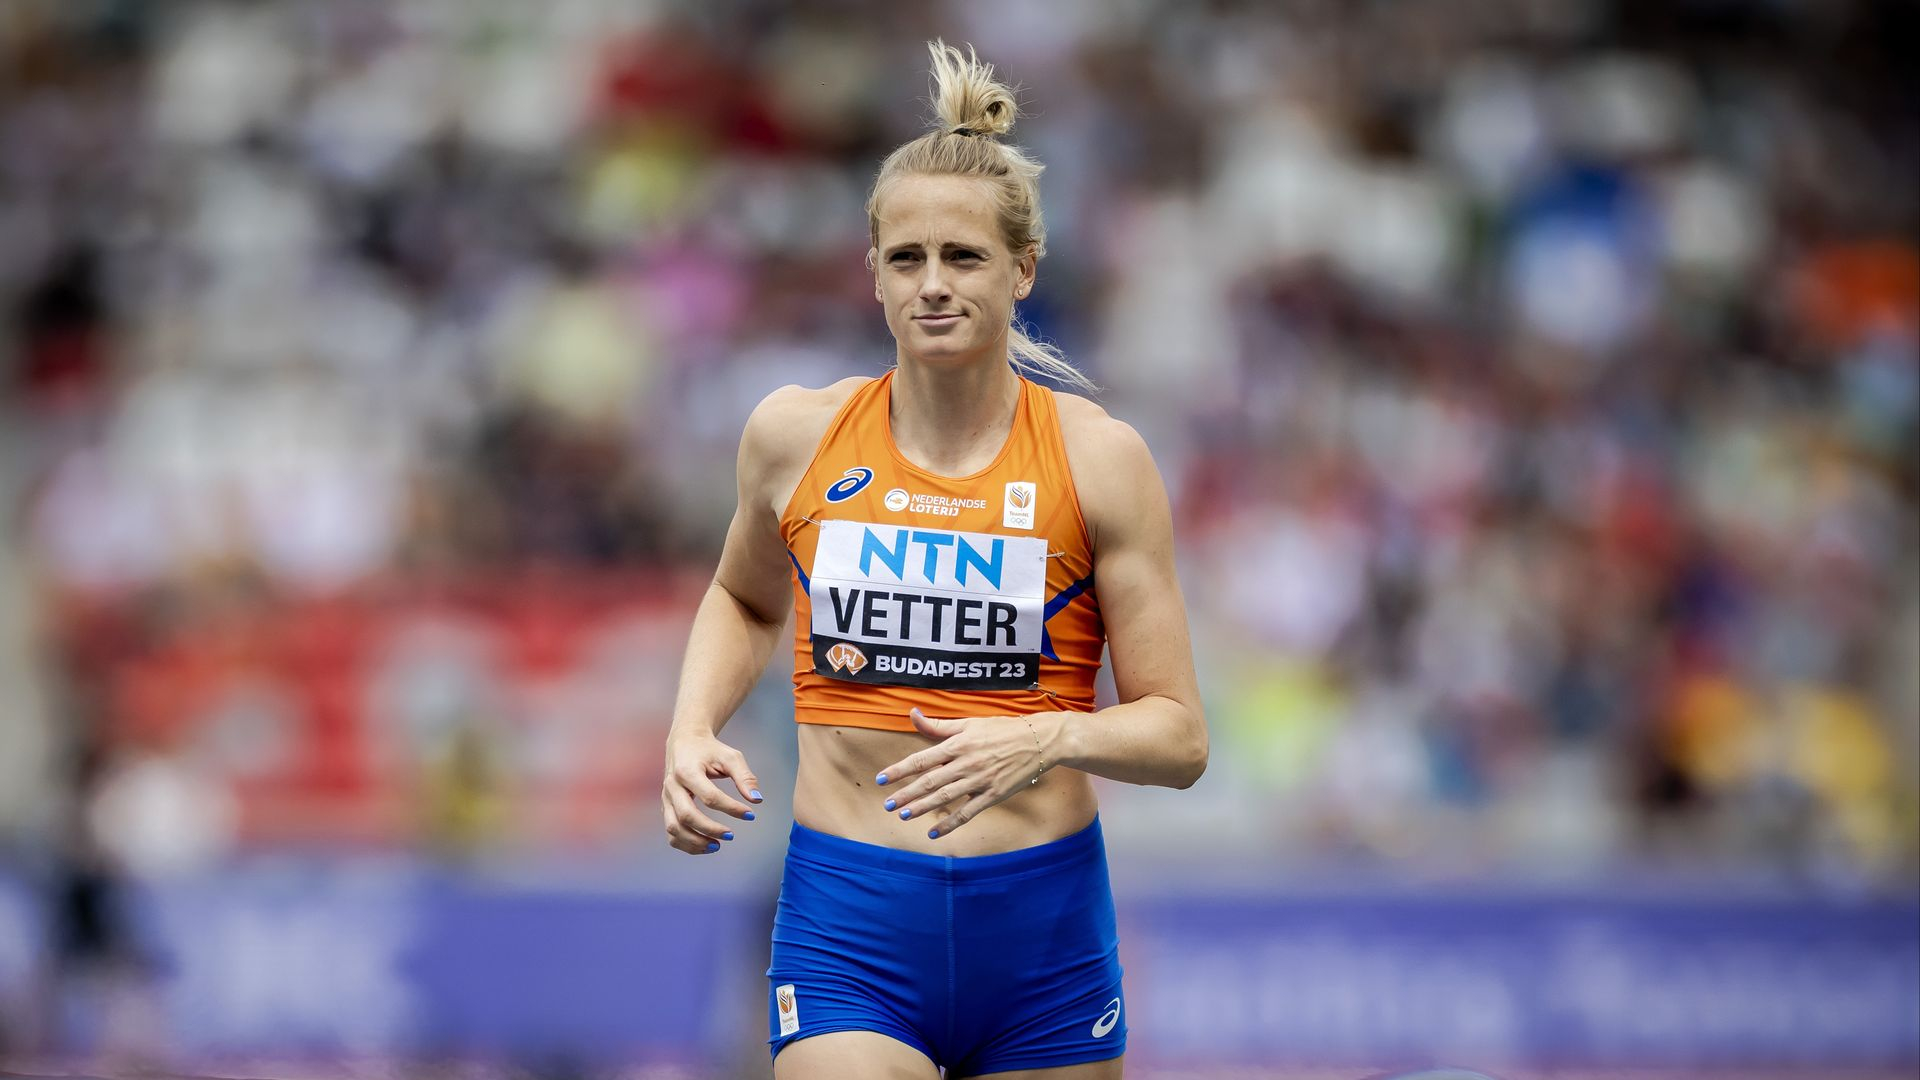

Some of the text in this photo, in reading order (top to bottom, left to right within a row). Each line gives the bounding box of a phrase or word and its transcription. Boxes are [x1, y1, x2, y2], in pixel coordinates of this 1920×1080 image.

[909, 502, 959, 517] LOTERIJ
[912, 493, 987, 509] NEDERLANDSE
[859, 526, 1005, 591] NTN
[829, 586, 1018, 647] VETTER
[875, 655, 1026, 678] BUDAPEST 23
